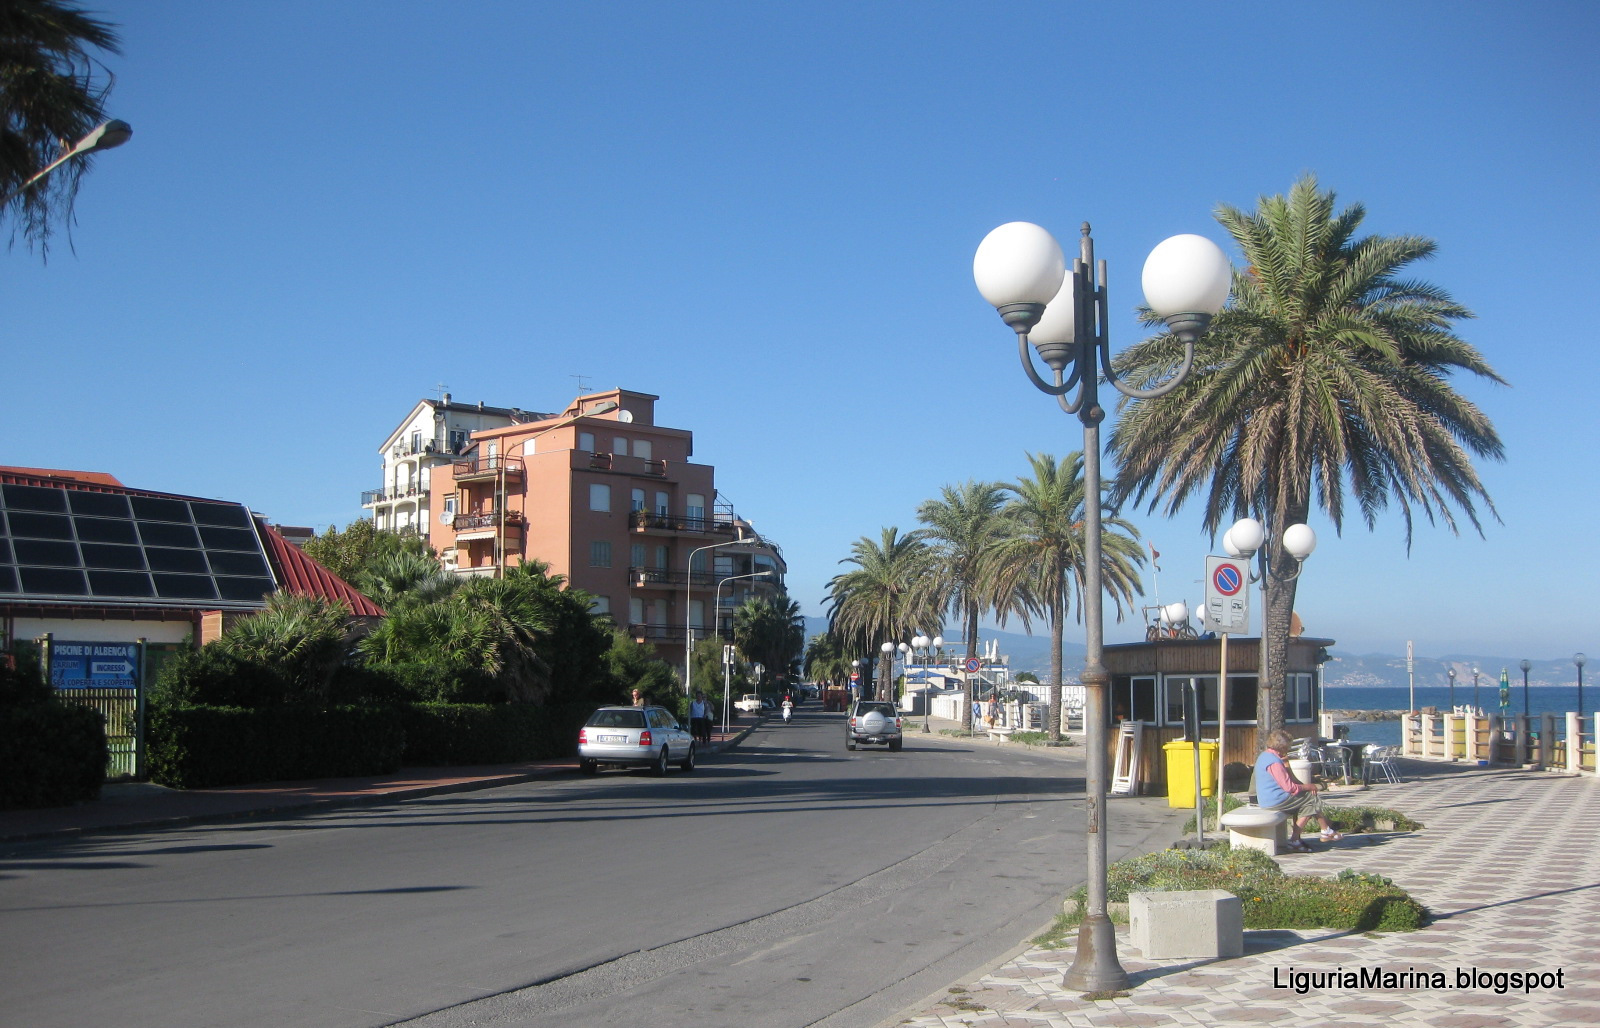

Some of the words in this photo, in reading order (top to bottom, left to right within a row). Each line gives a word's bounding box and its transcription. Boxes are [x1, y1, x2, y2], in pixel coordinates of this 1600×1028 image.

[54, 645, 83, 656] PISCINE
[84, 645, 93, 656] DI
[94, 645, 127, 656] ALBENGA
[96, 664, 126, 673] INGRESSO
[103, 679, 135, 687] SCOPERTA
